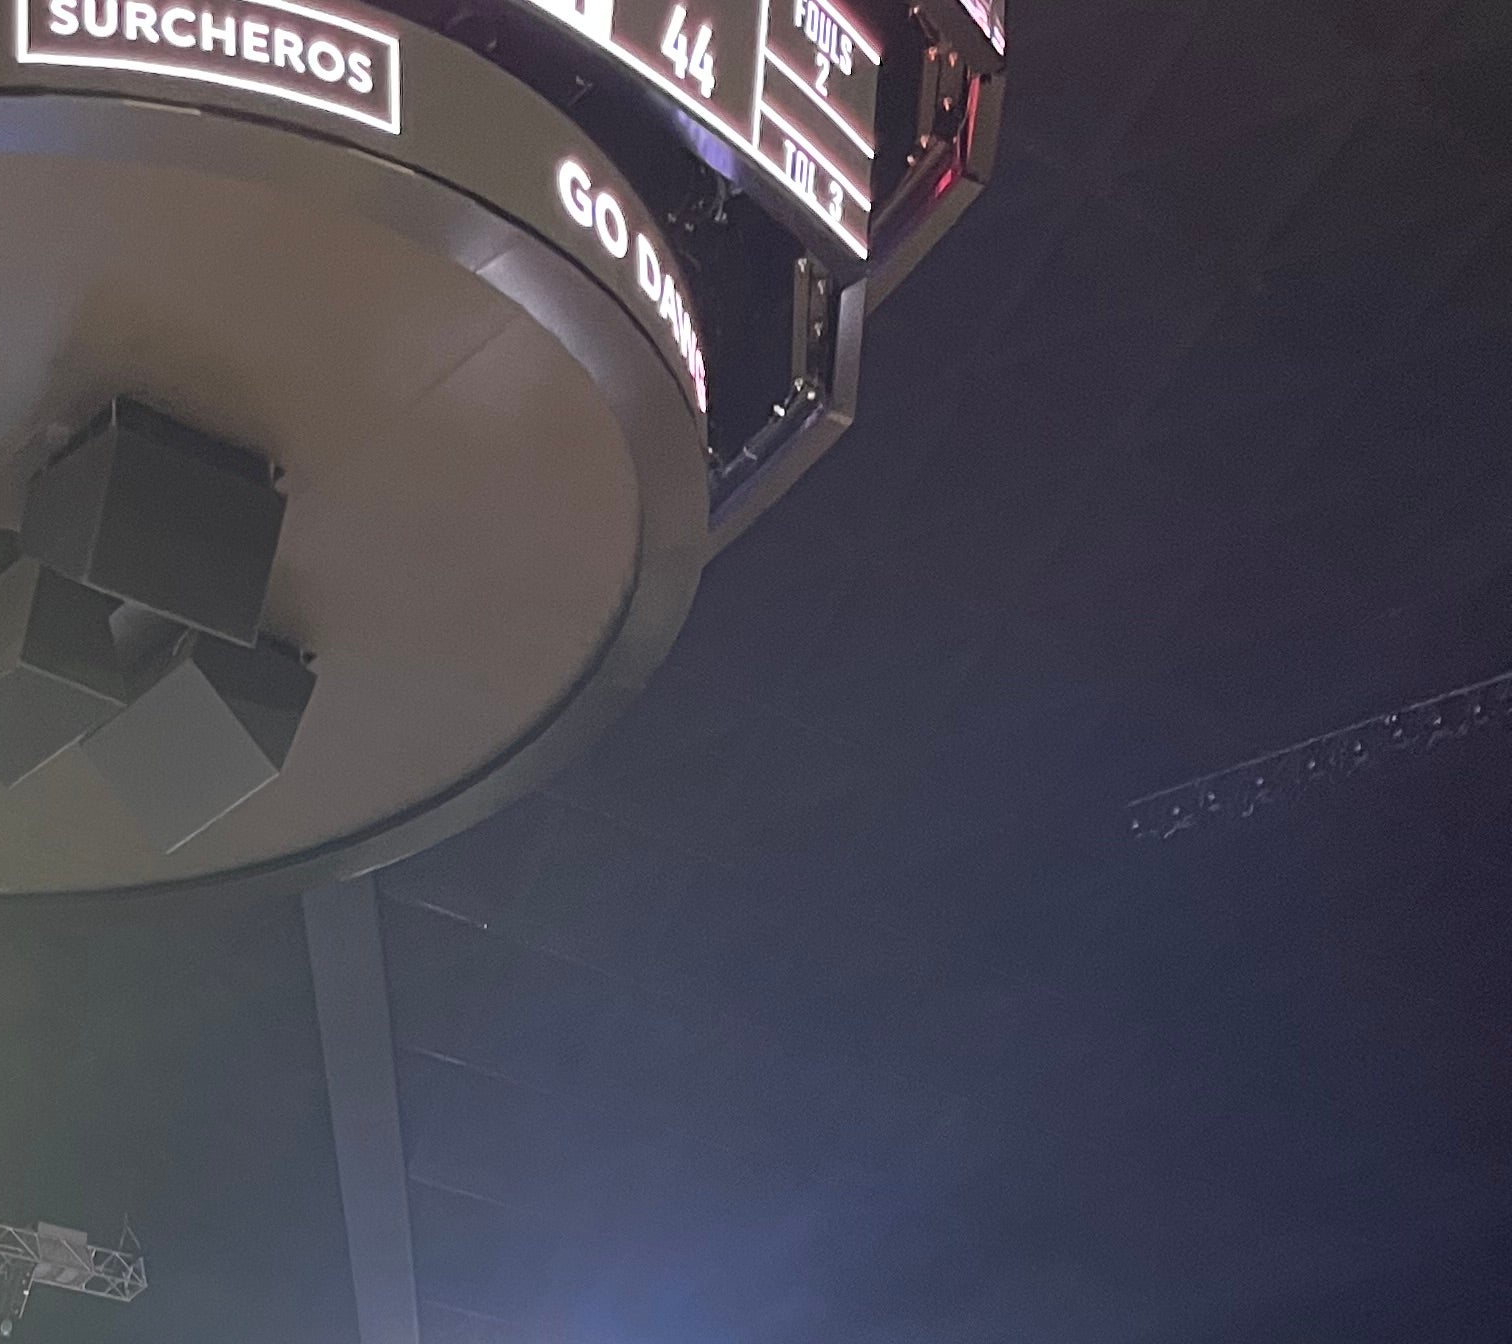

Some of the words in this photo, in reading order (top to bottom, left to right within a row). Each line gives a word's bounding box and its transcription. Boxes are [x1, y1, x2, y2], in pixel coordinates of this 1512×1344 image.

[48, 0, 374, 95] SURCHEROS
[660, 4, 716, 99] 44
[795, 0, 852, 75] FOULS
[815, 52, 830, 98] 2
[558, 160, 629, 259] GO
[827, 180, 844, 223] 3
